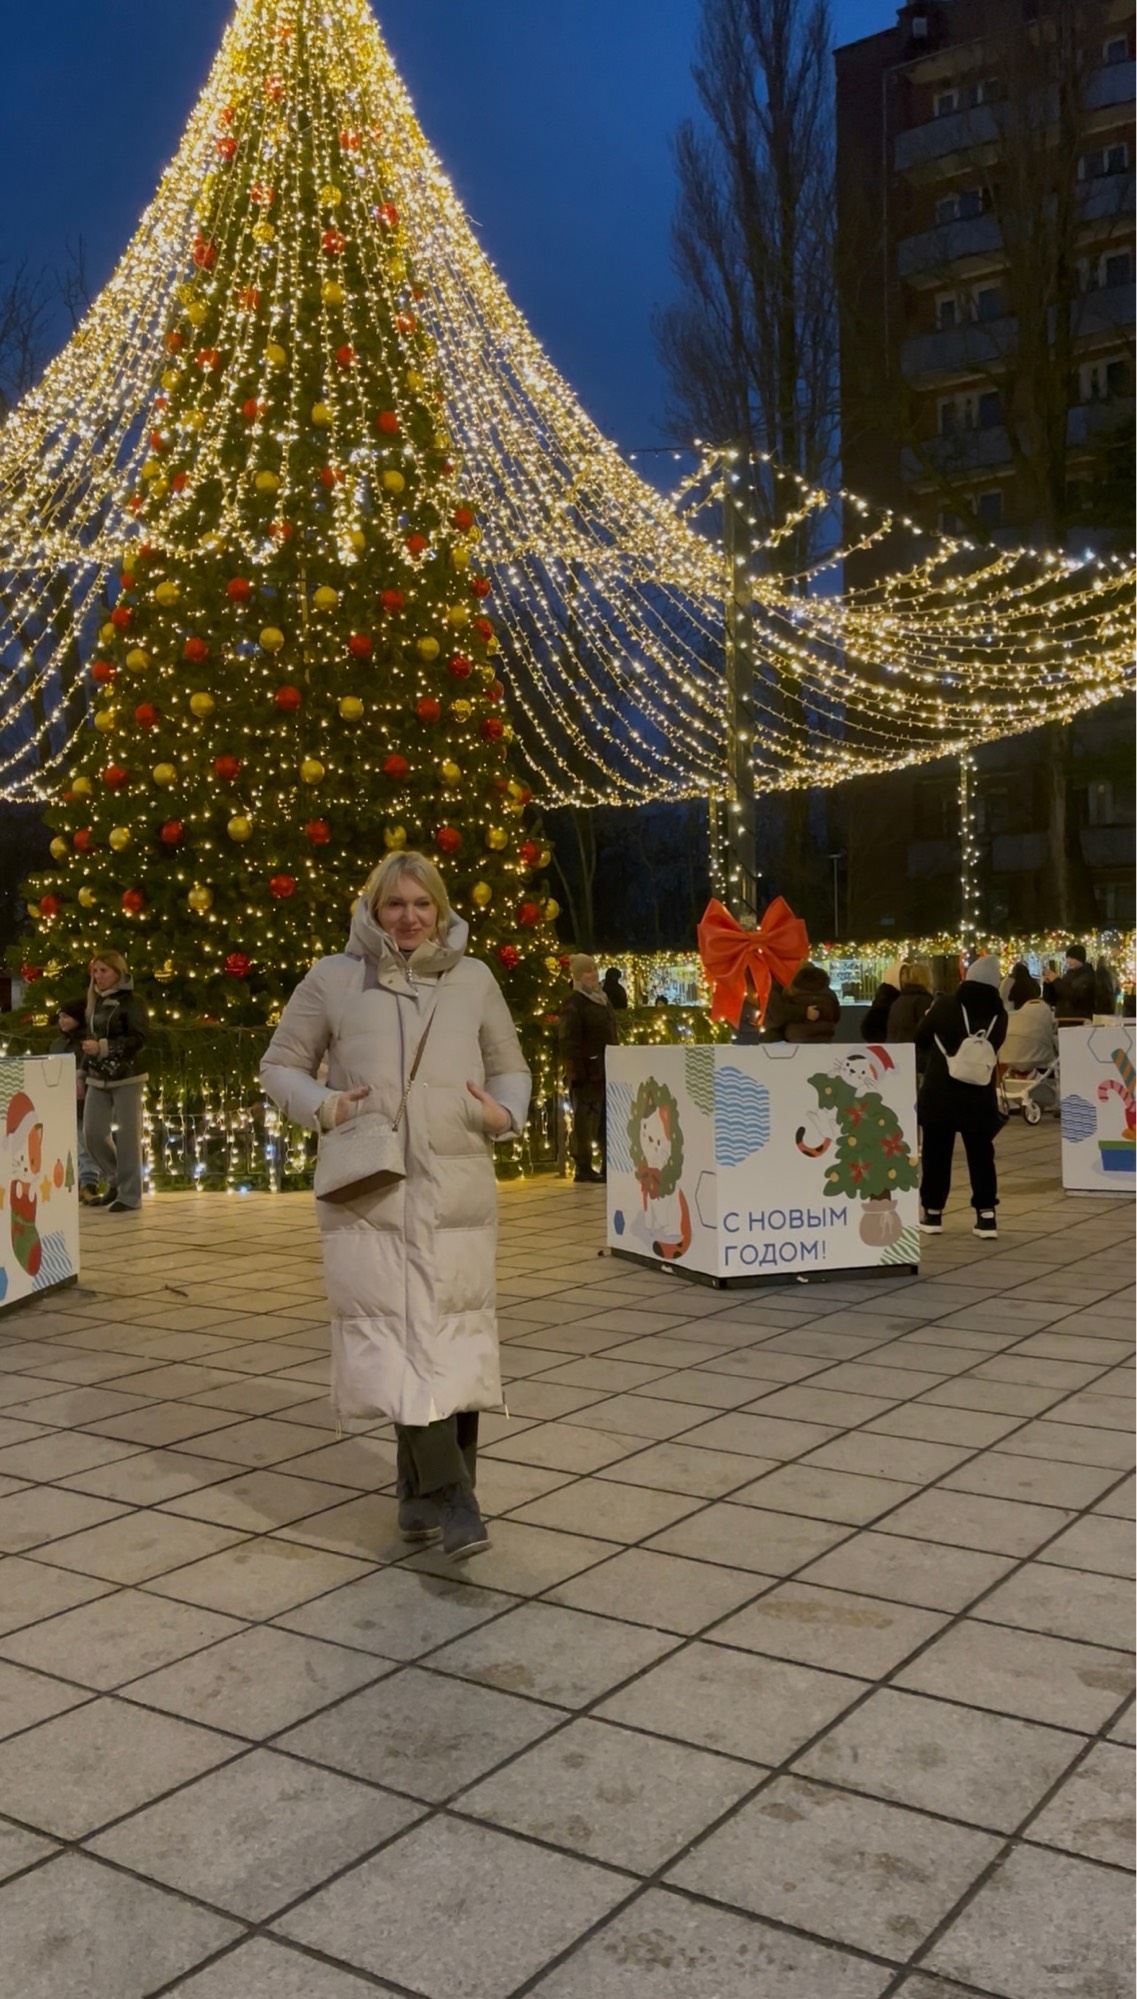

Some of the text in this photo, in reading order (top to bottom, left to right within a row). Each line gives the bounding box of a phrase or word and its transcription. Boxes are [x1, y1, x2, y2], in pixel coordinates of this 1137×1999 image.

[723, 1207, 847, 1233] С НОВЫМ
[724, 1241, 826, 1266] ГОДОМ!
